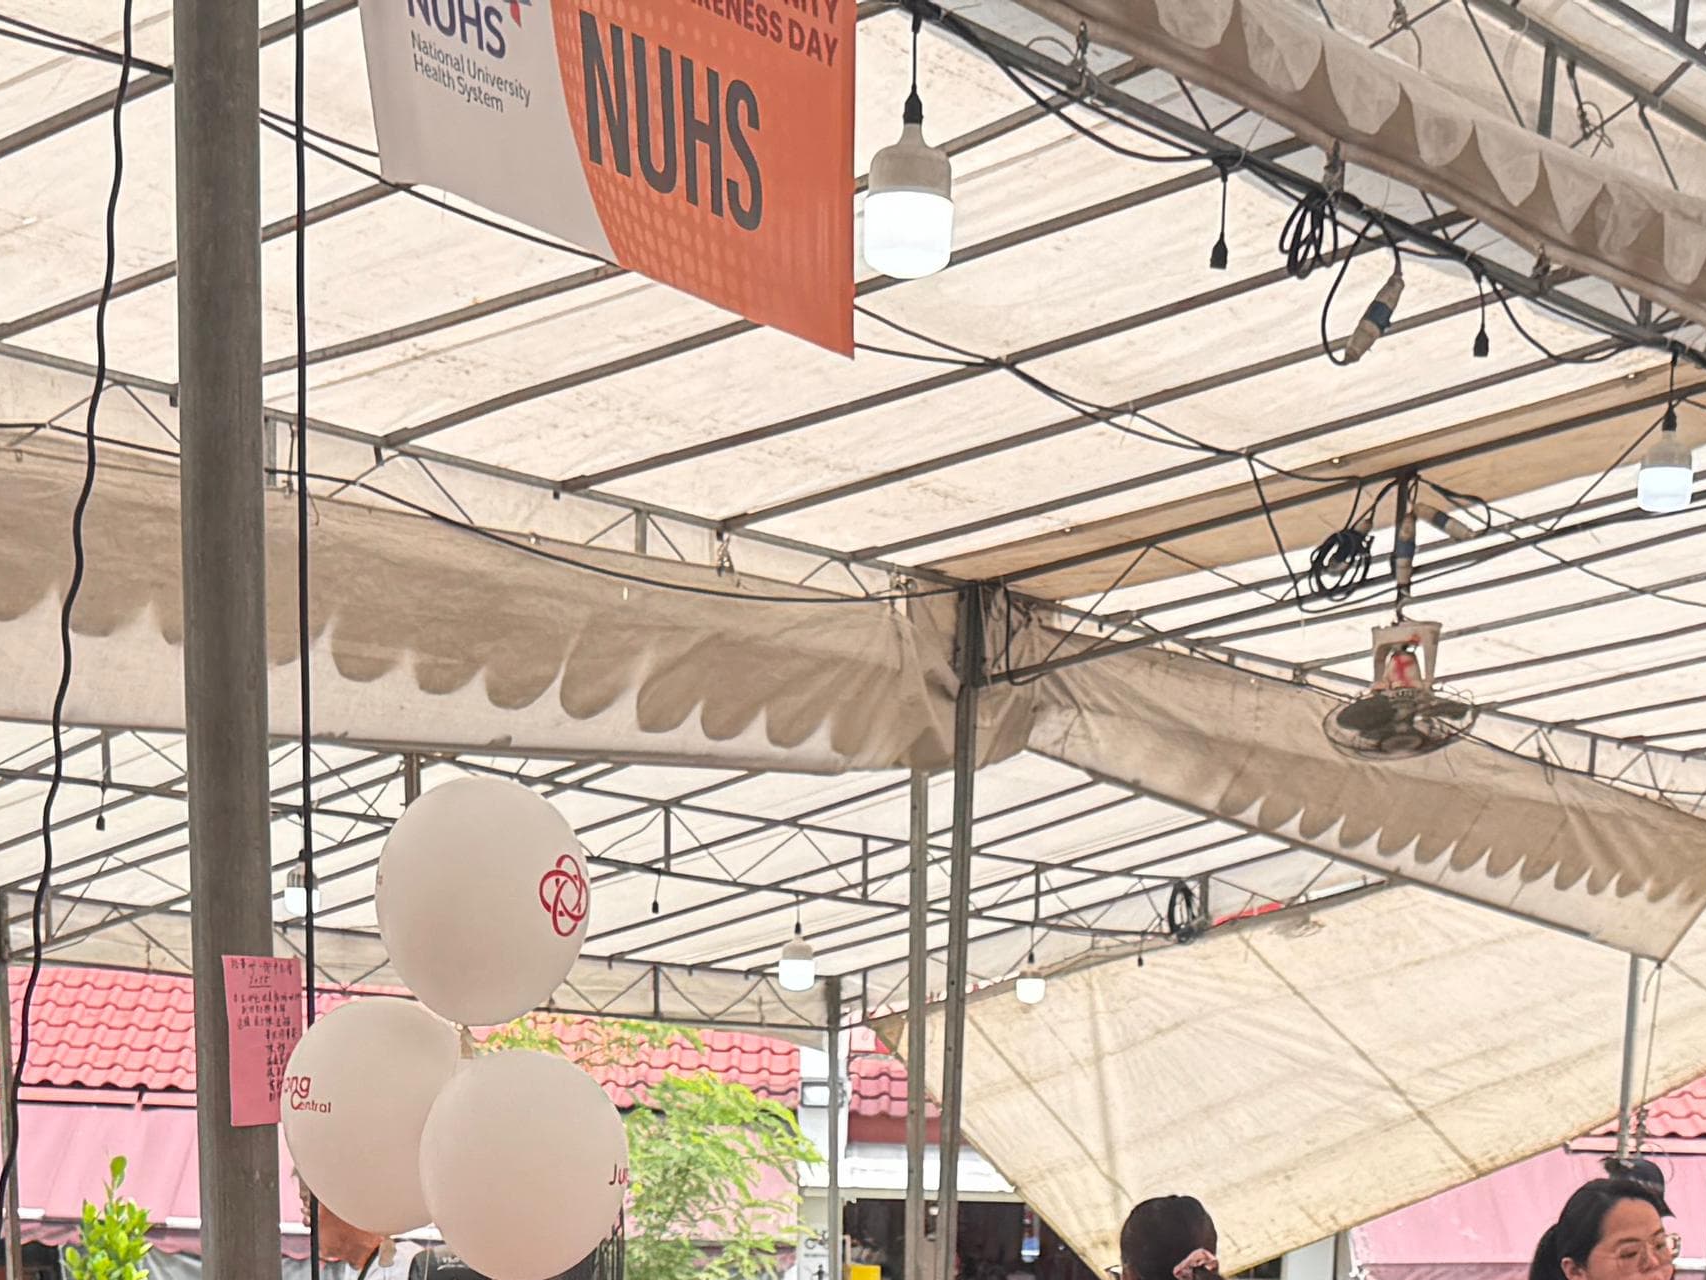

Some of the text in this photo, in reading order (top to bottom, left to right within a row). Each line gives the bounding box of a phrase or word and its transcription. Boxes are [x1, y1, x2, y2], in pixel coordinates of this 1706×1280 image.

[410, 30, 531, 108] National University
[788, 18, 838, 68] DAY
[413, 53, 504, 113] Health System
[579, 12, 763, 231] NUHS
[284, 1075, 311, 1099] ong
